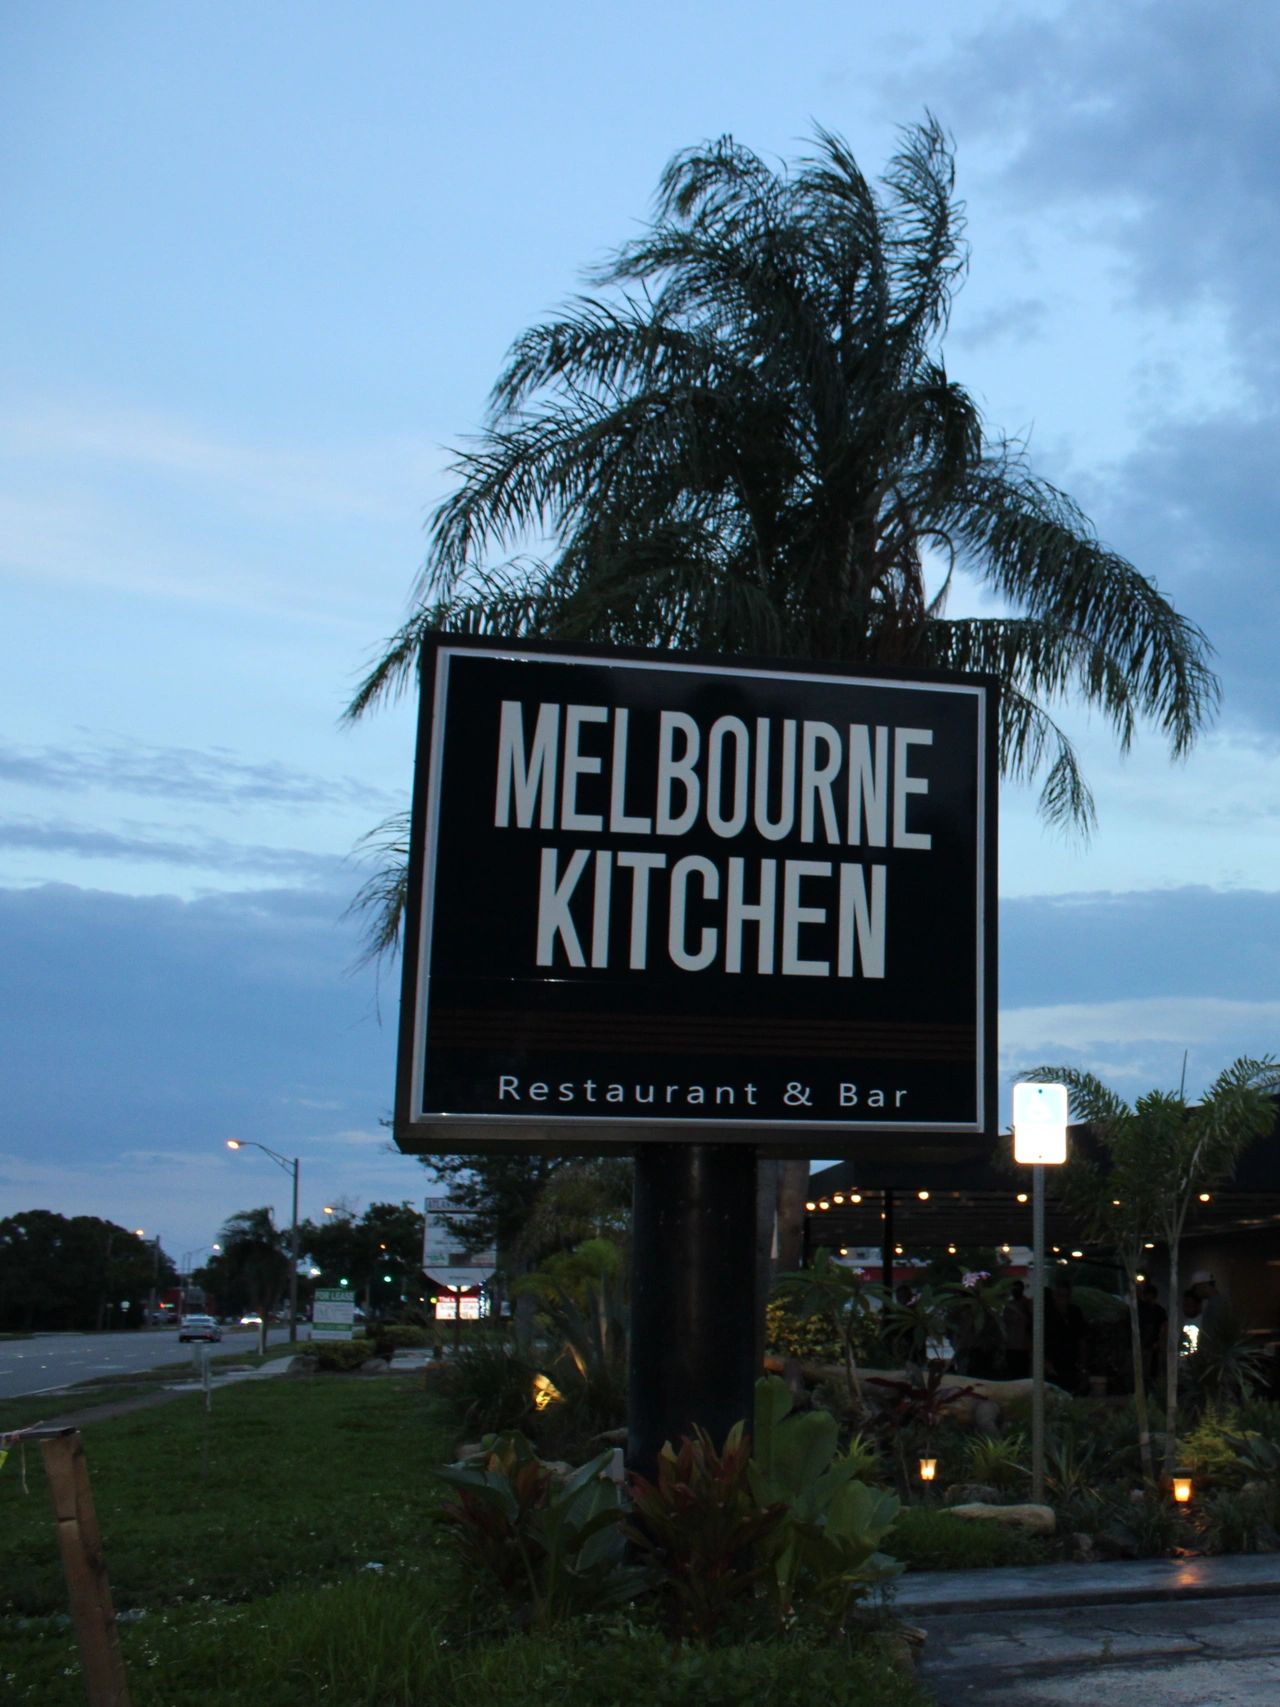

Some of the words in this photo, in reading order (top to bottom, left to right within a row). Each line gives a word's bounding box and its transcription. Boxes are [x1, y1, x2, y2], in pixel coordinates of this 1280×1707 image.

[494, 700, 933, 850] MELBOURNE
[536, 847, 887, 979] KITCHEN
[499, 1075, 757, 1105] Restaurant
[783, 1082, 813, 1106] &
[839, 1083, 907, 1107] Bar
[315, 1290, 330, 1301] FOR
[331, 1290, 355, 1302] LEASE
